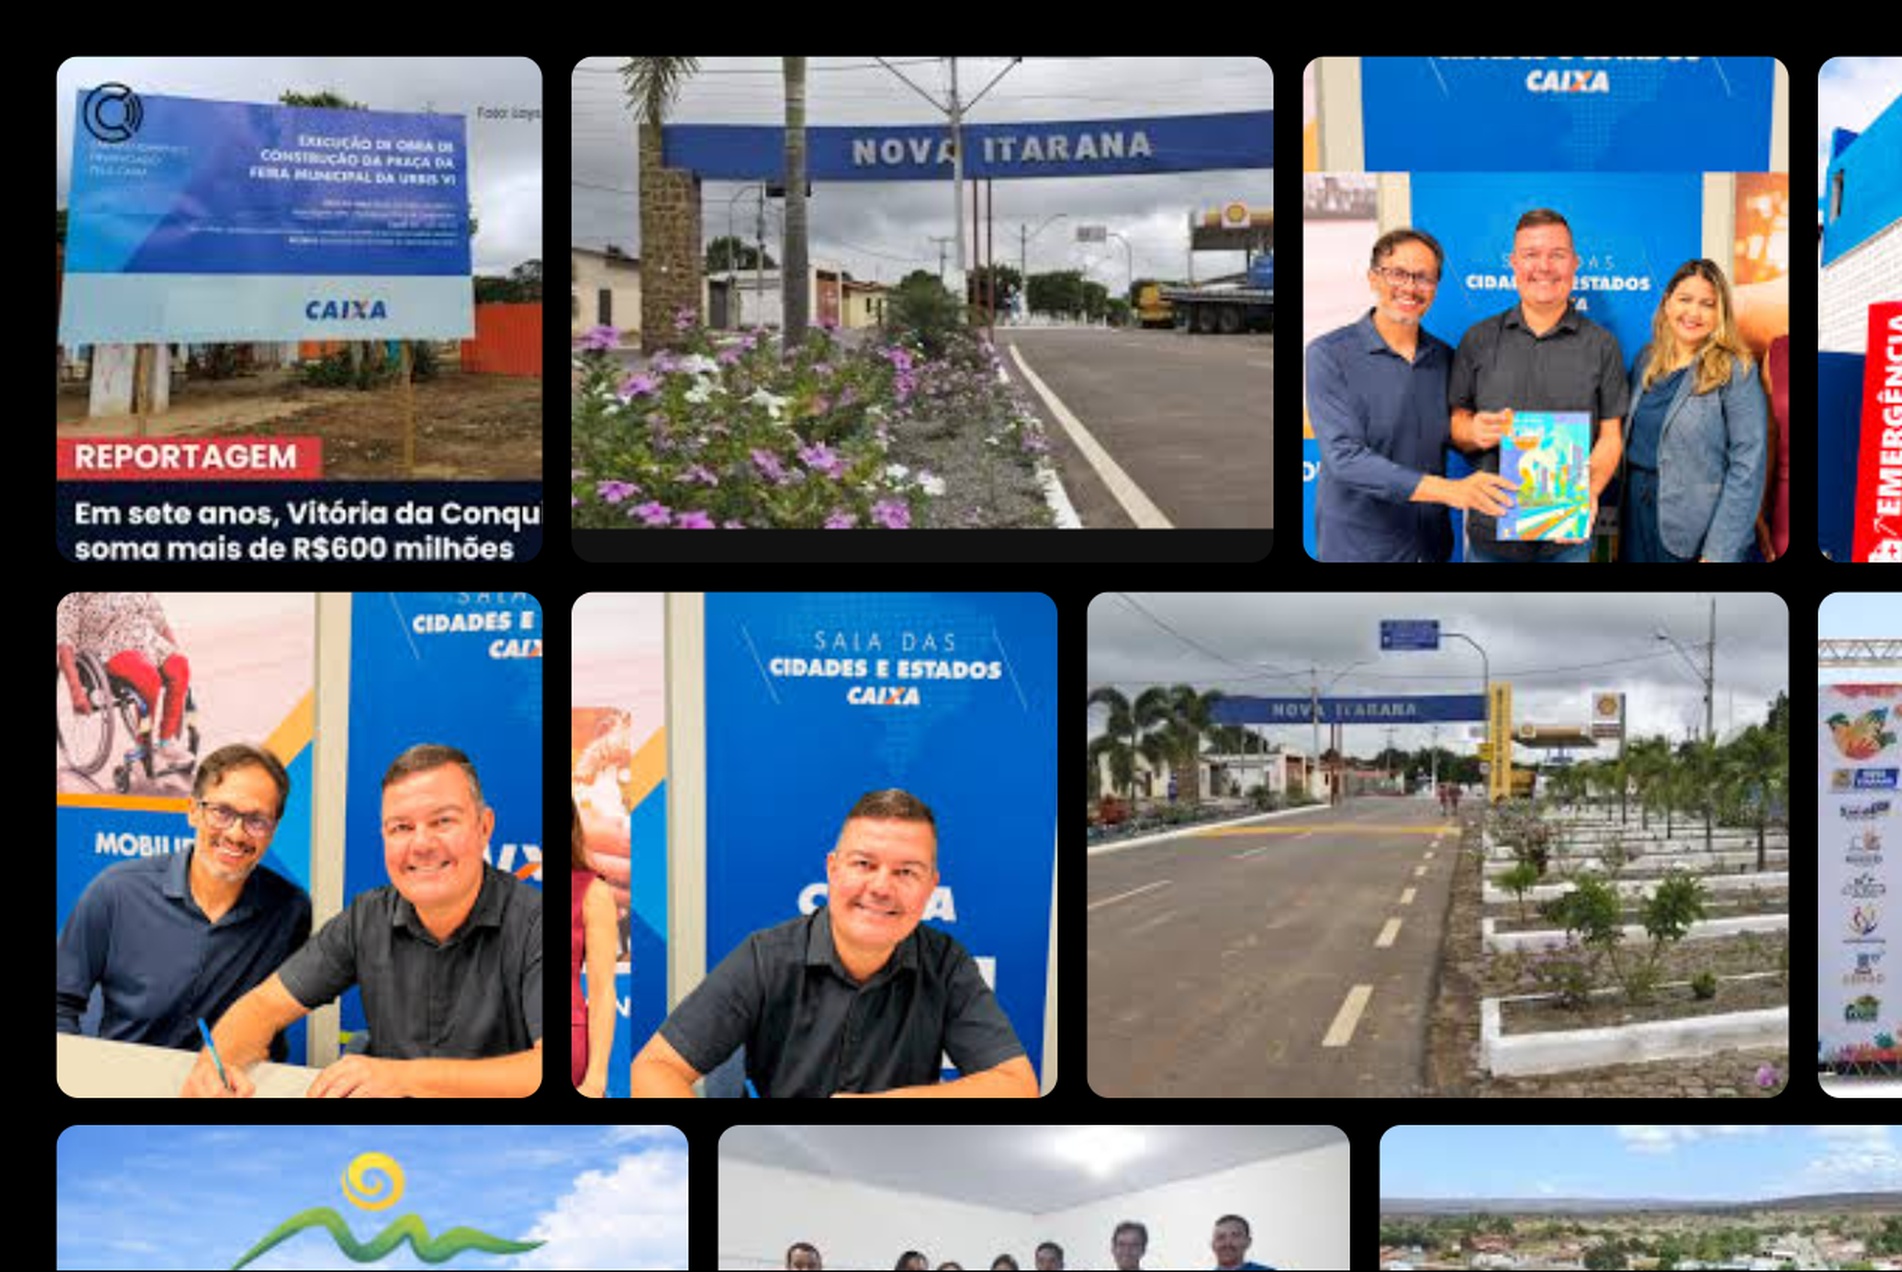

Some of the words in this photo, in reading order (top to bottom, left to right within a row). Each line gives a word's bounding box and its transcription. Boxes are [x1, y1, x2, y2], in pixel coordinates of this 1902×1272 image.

[1525, 69, 1609, 92] CAIXA
[299, 133, 371, 151] EXECUÇÃO
[376, 139, 391, 151] DE
[395, 139, 433, 152] OBRA
[438, 140, 454, 153] DE
[852, 137, 957, 165] NOVA
[983, 131, 1153, 163] ITARANA
[260, 148, 358, 167] CONSTRUÇÃO
[362, 153, 384, 167] DA
[387, 155, 431, 170] PRAÇA
[434, 157, 456, 170] DA
[250, 165, 290, 180] FEIRA
[294, 167, 373, 184] MUNICIPAL
[376, 173, 396, 185] DA
[1465, 274, 1517, 290] CIDA
[305, 300, 388, 320] CAIXA
[412, 612, 512, 633] CIDADES
[520, 610, 535, 630] E
[488, 638, 543, 659] CAIX
[815, 630, 882, 651] SALA
[902, 632, 955, 652] DAS
[769, 658, 868, 678] CIDADES
[877, 659, 889, 678] E
[897, 660, 1002, 680] ESTADOS
[847, 686, 920, 705] CAIXA
